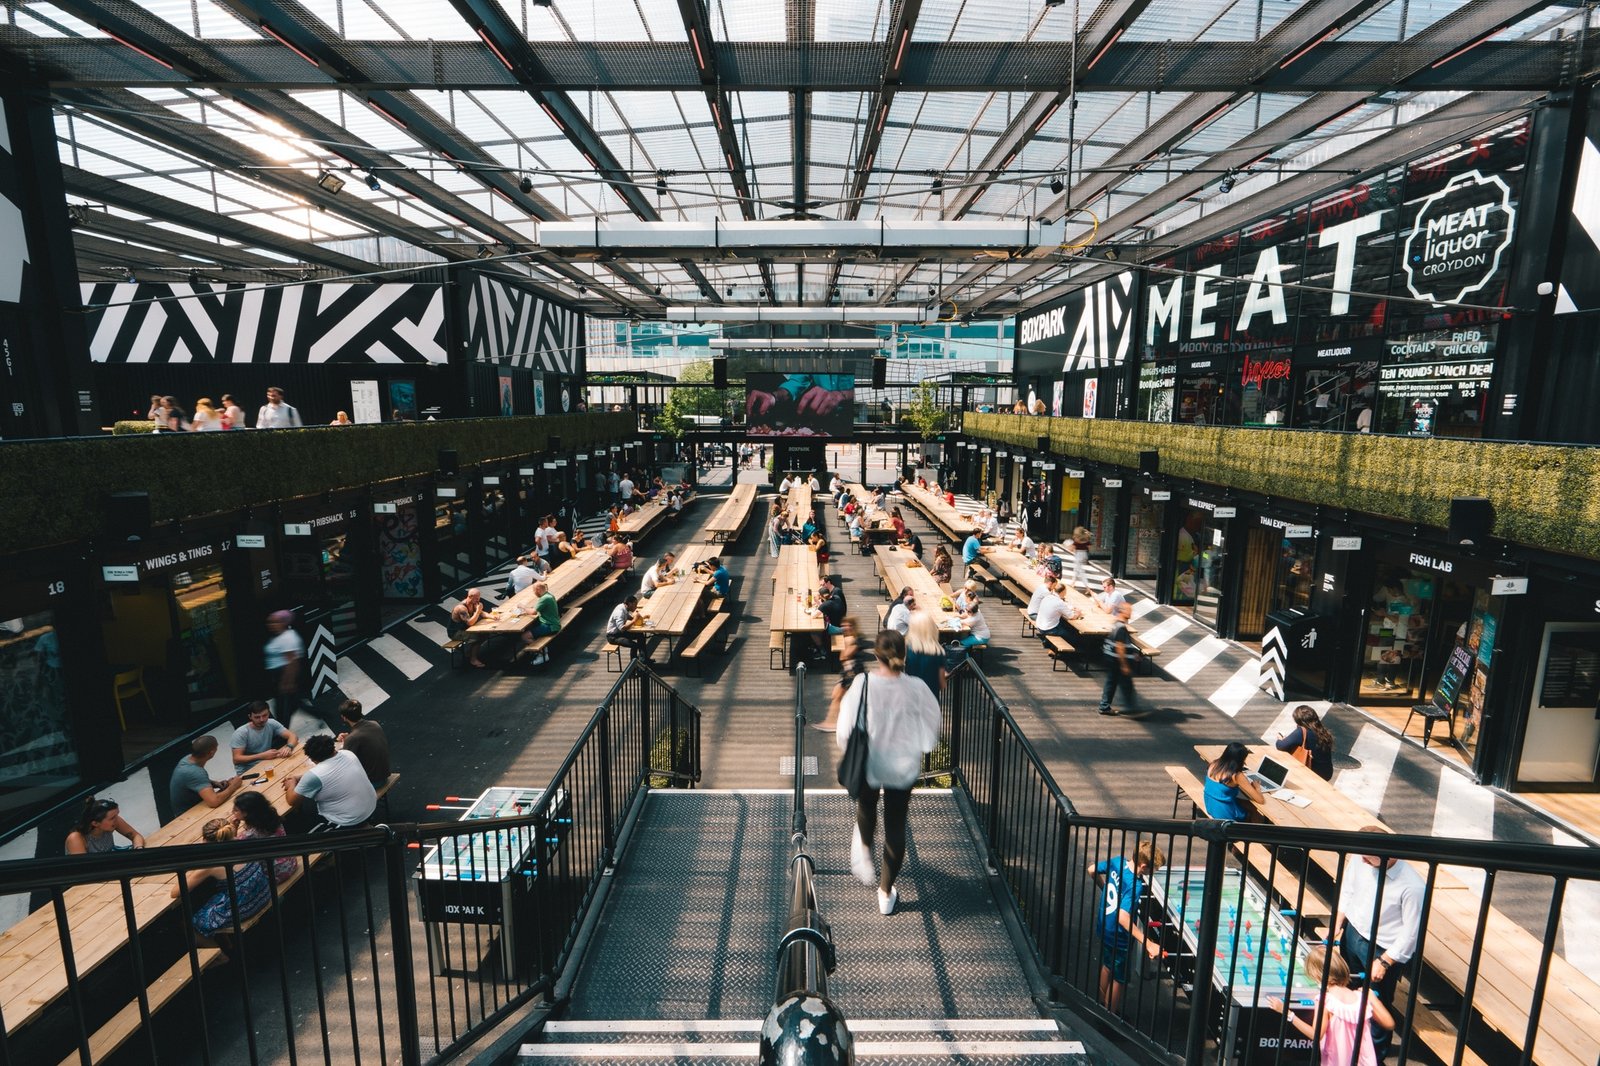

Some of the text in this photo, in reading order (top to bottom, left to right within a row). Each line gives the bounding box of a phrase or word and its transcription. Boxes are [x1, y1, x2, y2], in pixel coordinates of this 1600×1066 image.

[1426, 202, 1495, 239] MEAT
[1424, 229, 1489, 262] liquor
[1422, 253, 1486, 276] CROYDON
[1147, 210, 1382, 346] MEAT
[1021, 306, 1067, 345] BOXPARK
[1452, 331, 1481, 343] FRIED
[1318, 347, 1351, 357] MEATLIQUOR
[1398, 365, 1432, 378] POUNDS
[1434, 364, 1466, 376] LUNCH
[1188, 498, 1198, 507] THAI
[316, 513, 343, 527] RIBSHACK
[1260, 516, 1273, 526] THAI
[145, 553, 177, 570] WINGS
[179, 552, 187, 562] &
[187, 545, 213, 560] TINGS
[221, 540, 231, 551] 17
[1409, 552, 1453, 573] FISH LAB
[48, 581, 65, 595] 18
[1106, 882, 1118, 915] 9
